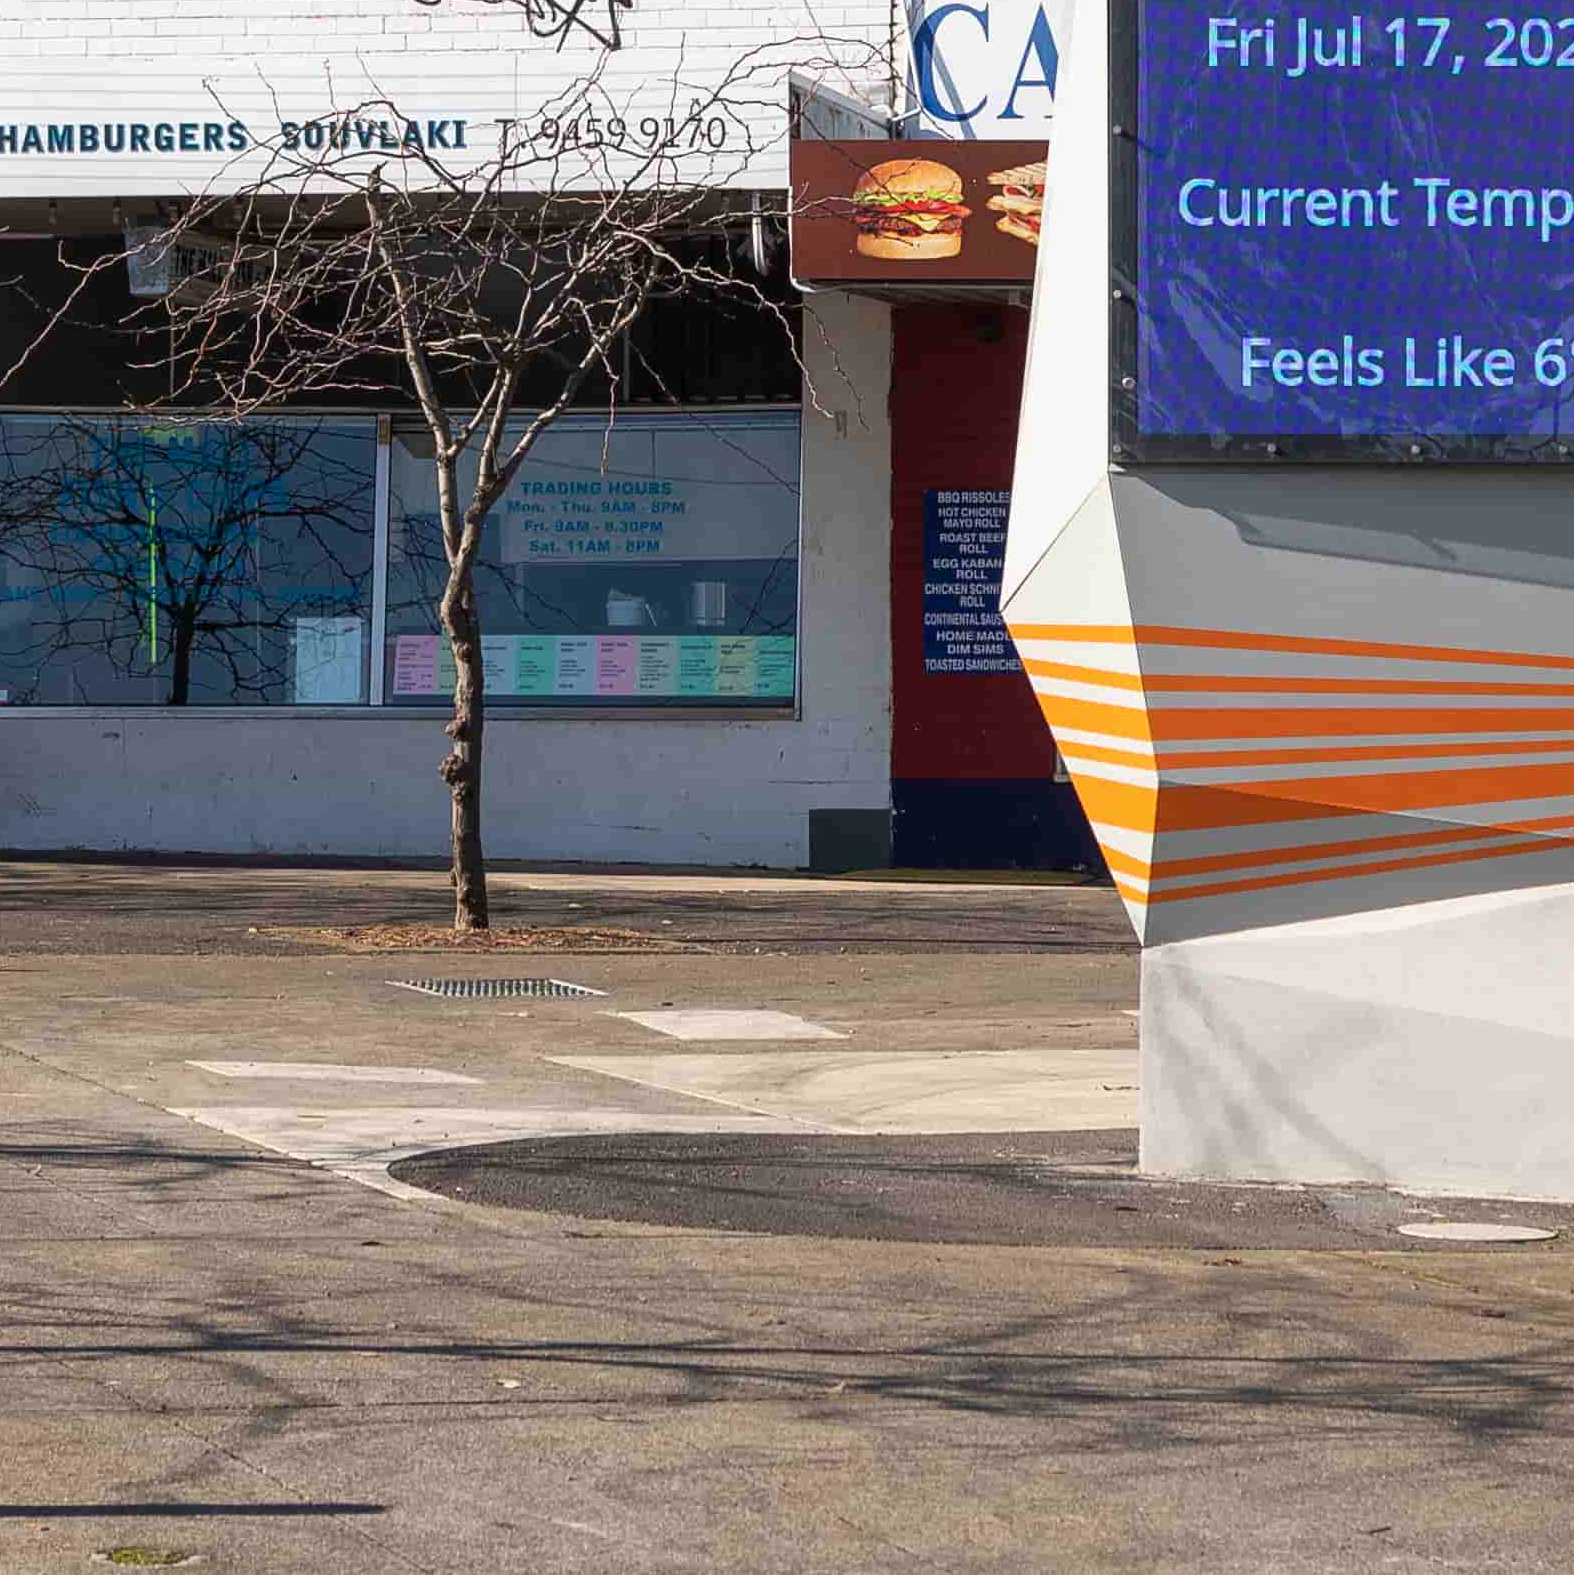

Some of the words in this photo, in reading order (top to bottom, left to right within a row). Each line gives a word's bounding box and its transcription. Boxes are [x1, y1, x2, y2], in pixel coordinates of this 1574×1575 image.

[1207, 16, 1276, 67] Fri
[1287, 16, 1363, 76] Jul
[1384, 18, 1465, 75] 17,
[280, 118, 467, 151] SOUVLAKI
[542, 117, 627, 150] 9459
[638, 116, 727, 149] 9170
[1177, 177, 1399, 228] Current
[1241, 335, 1386, 388] Feels
[1406, 335, 1516, 388] Like
[521, 481, 603, 496] TRADING
[608, 481, 674, 496] HOURS
[937, 491, 960, 504] BBQ
[938, 507, 959, 517] HOT
[960, 507, 1005, 517] CHICKEN
[943, 518, 973, 528] MAYO
[975, 518, 1001, 528] ROLL
[939, 533, 977, 543] ROAST
[959, 544, 989, 554] ROLL
[933, 558, 959, 569] EGG
[961, 558, 1002, 569] KABAN
[956, 569, 988, 579] ROLL
[925, 583, 967, 594] CHICKEN
[968, 583, 1001, 594] SCHNI
[960, 596, 986, 607] ROLL
[980, 613, 1002, 625] SAUS
[936, 630, 975, 641] HOME
[947, 644, 971, 655] DIM
[973, 644, 1004, 654] SIMS
[925, 658, 965, 671] TOASTED
